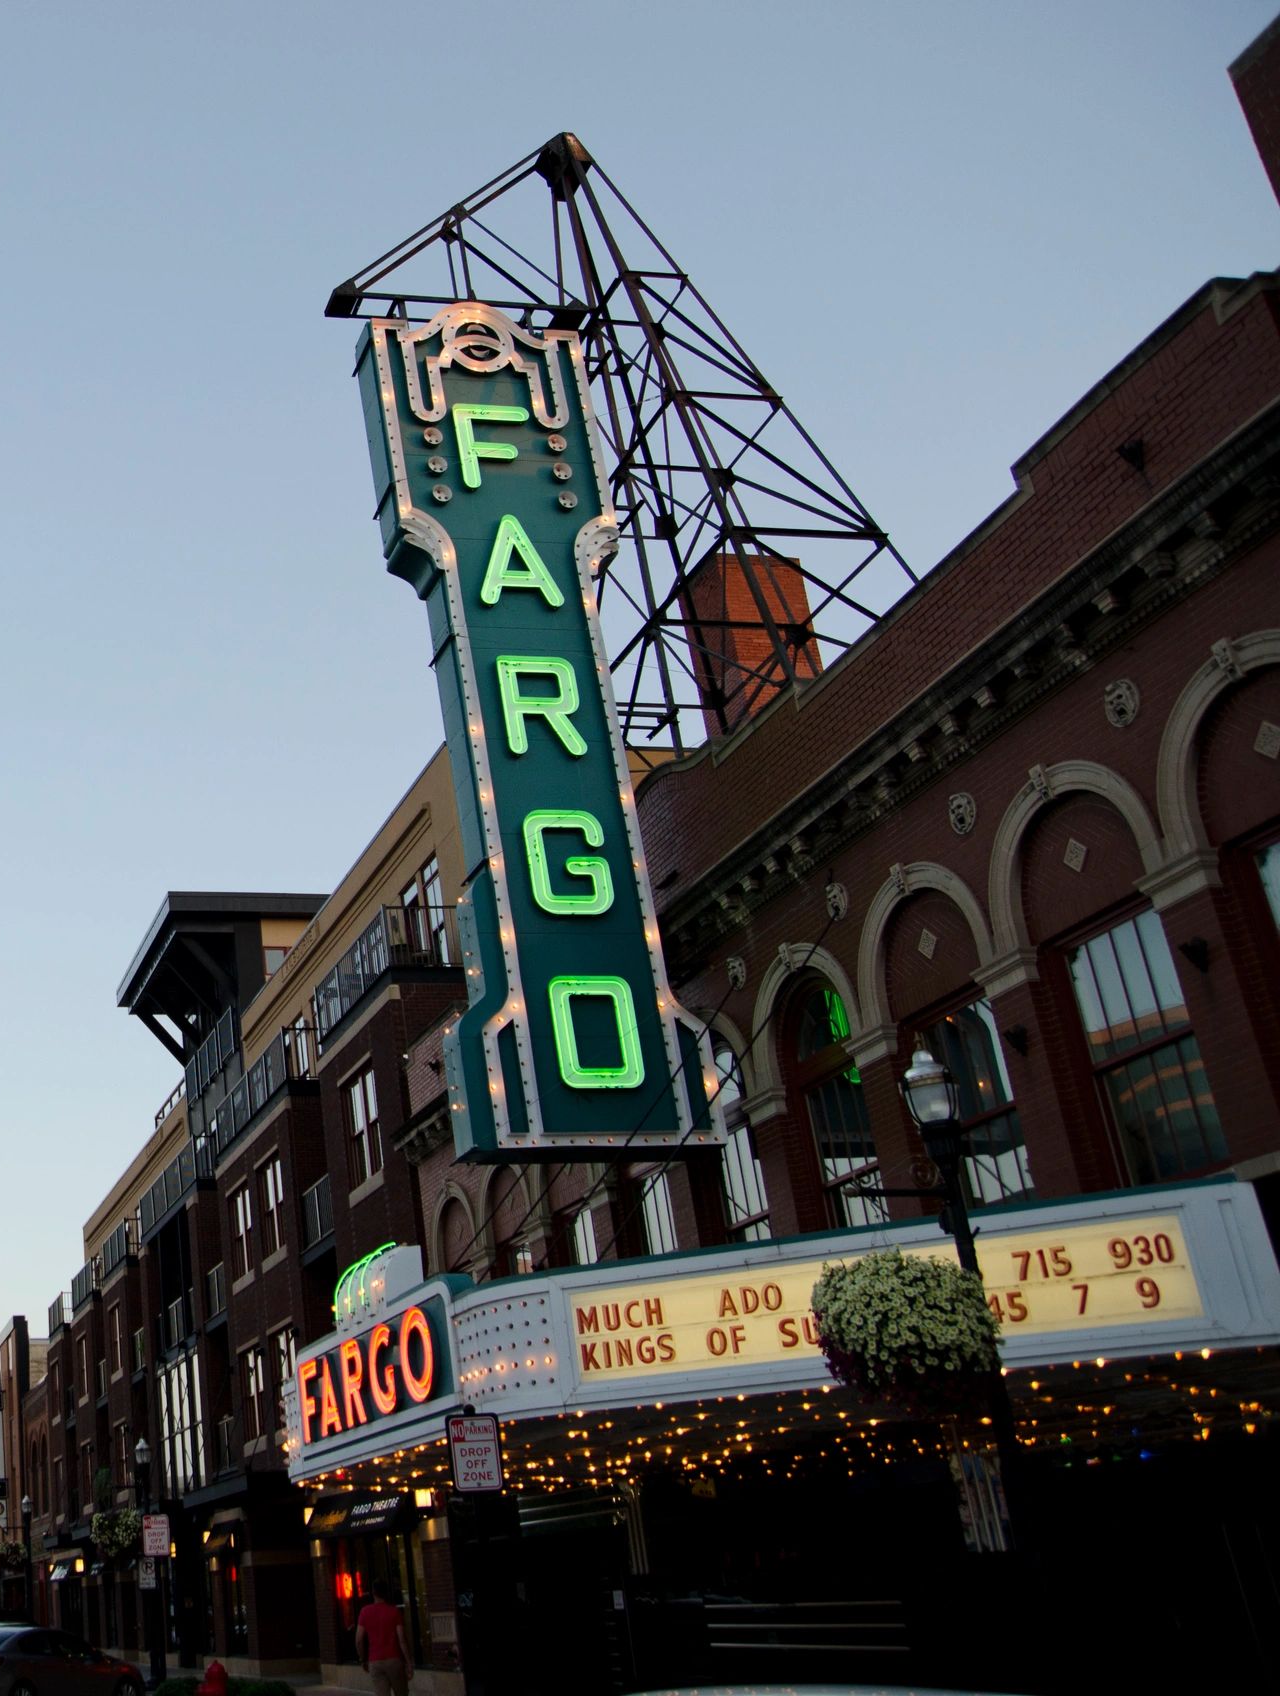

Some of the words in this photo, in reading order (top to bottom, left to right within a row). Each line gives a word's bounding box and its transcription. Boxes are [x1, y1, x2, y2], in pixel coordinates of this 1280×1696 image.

[452, 403, 644, 1089] FARGO
[576, 1298, 664, 1335] MUCH
[719, 1282, 782, 1318] ADO
[1011, 1246, 1072, 1281] 715
[1108, 1233, 1175, 1269] 930
[580, 1334, 676, 1371] KINGS
[706, 1324, 746, 1356] OF
[1072, 1284, 1089, 1315] 7
[1135, 1277, 1160, 1308] 9
[298, 1305, 433, 1444] FARGO
[451, 1424, 464, 1438] NO
[464, 1424, 493, 1434] PARKING
[460, 1447, 491, 1457] DROP
[463, 1471, 494, 1481] ZONE
[466, 1459, 488, 1469] OFF
